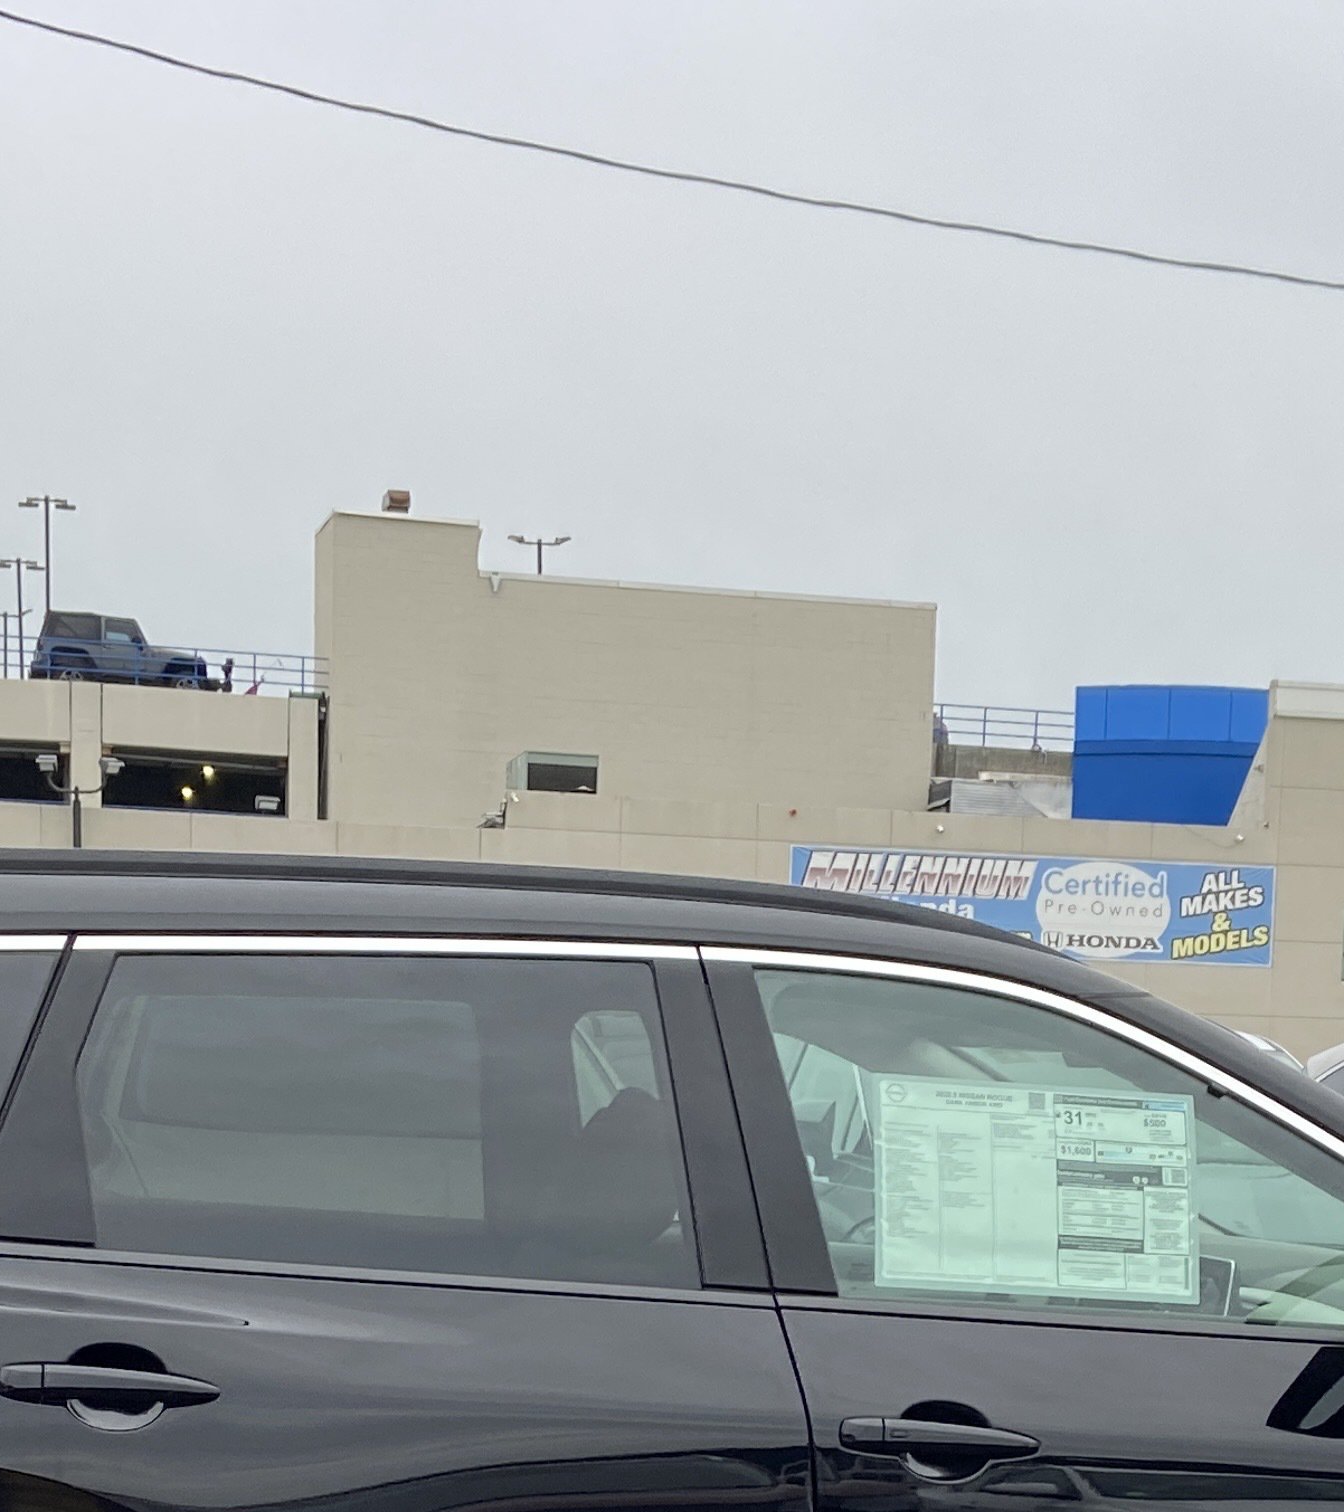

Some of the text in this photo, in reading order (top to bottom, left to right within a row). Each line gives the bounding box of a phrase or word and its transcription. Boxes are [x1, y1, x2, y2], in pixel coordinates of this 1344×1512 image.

[801, 850, 1040, 900] MILLENNIUM
[1044, 870, 1166, 899] Certified
[1200, 869, 1246, 895] ALL
[1044, 900, 1163, 918] Pre-Owned
[1180, 884, 1265, 918] MAKES
[1212, 911, 1232, 933] &
[1067, 934, 1161, 951] HONDA
[1171, 925, 1270, 960] MODELS
[1064, 1110, 1082, 1126] 31
